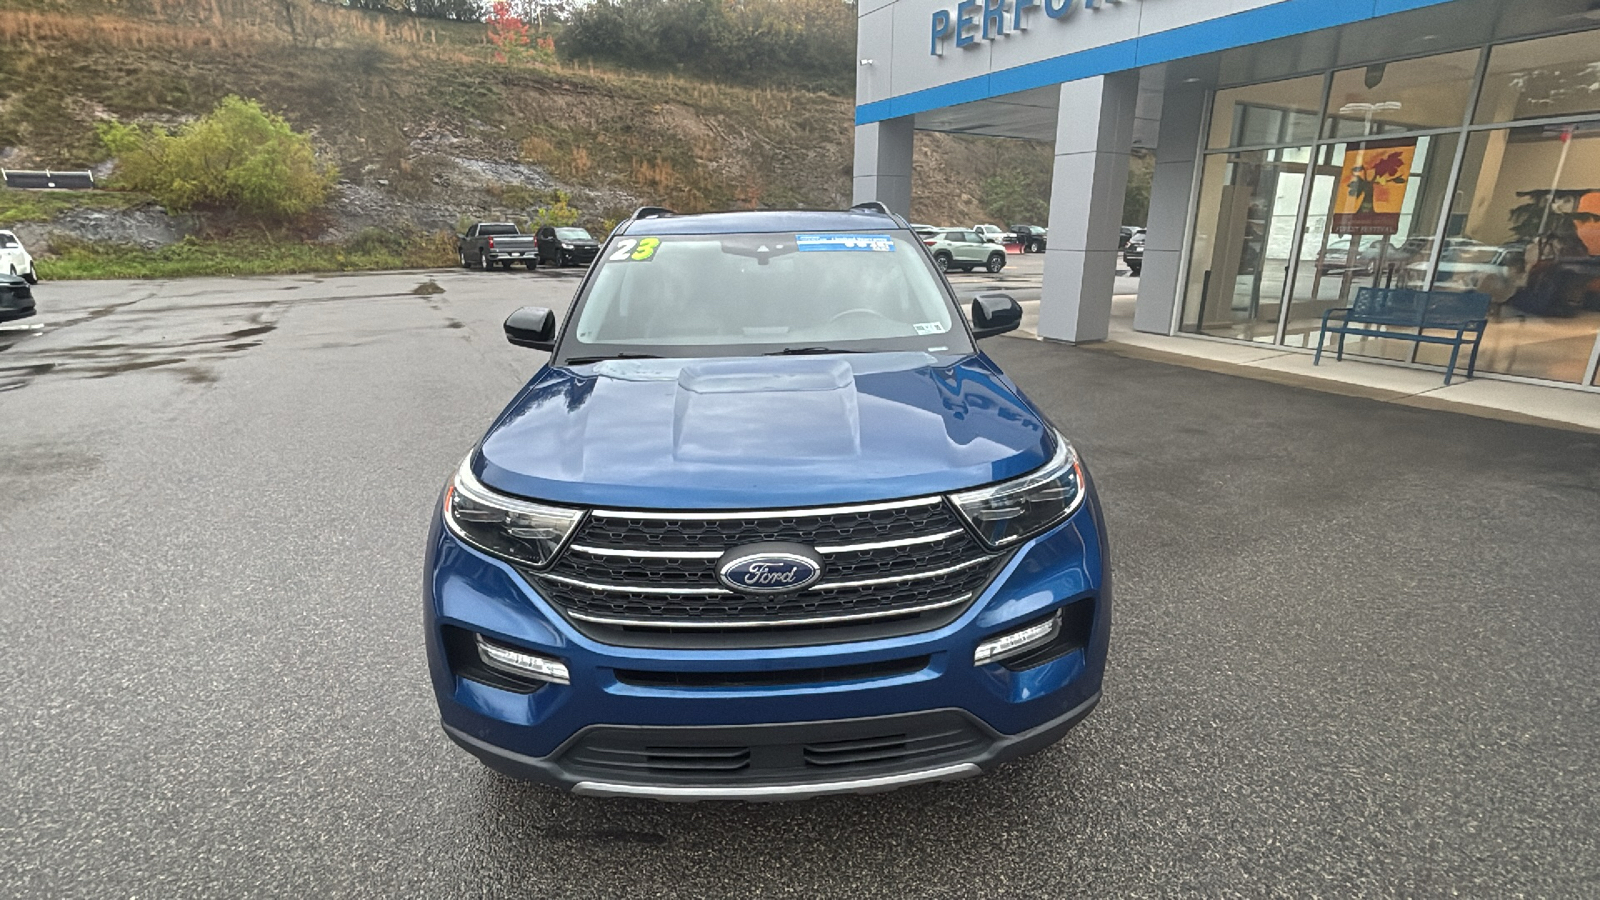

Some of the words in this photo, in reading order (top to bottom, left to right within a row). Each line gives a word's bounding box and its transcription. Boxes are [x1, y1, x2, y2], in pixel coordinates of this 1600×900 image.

[930, 0, 1110, 56] PERF
[609, 237, 660, 261] 23
[744, 562, 798, 585] Ford
